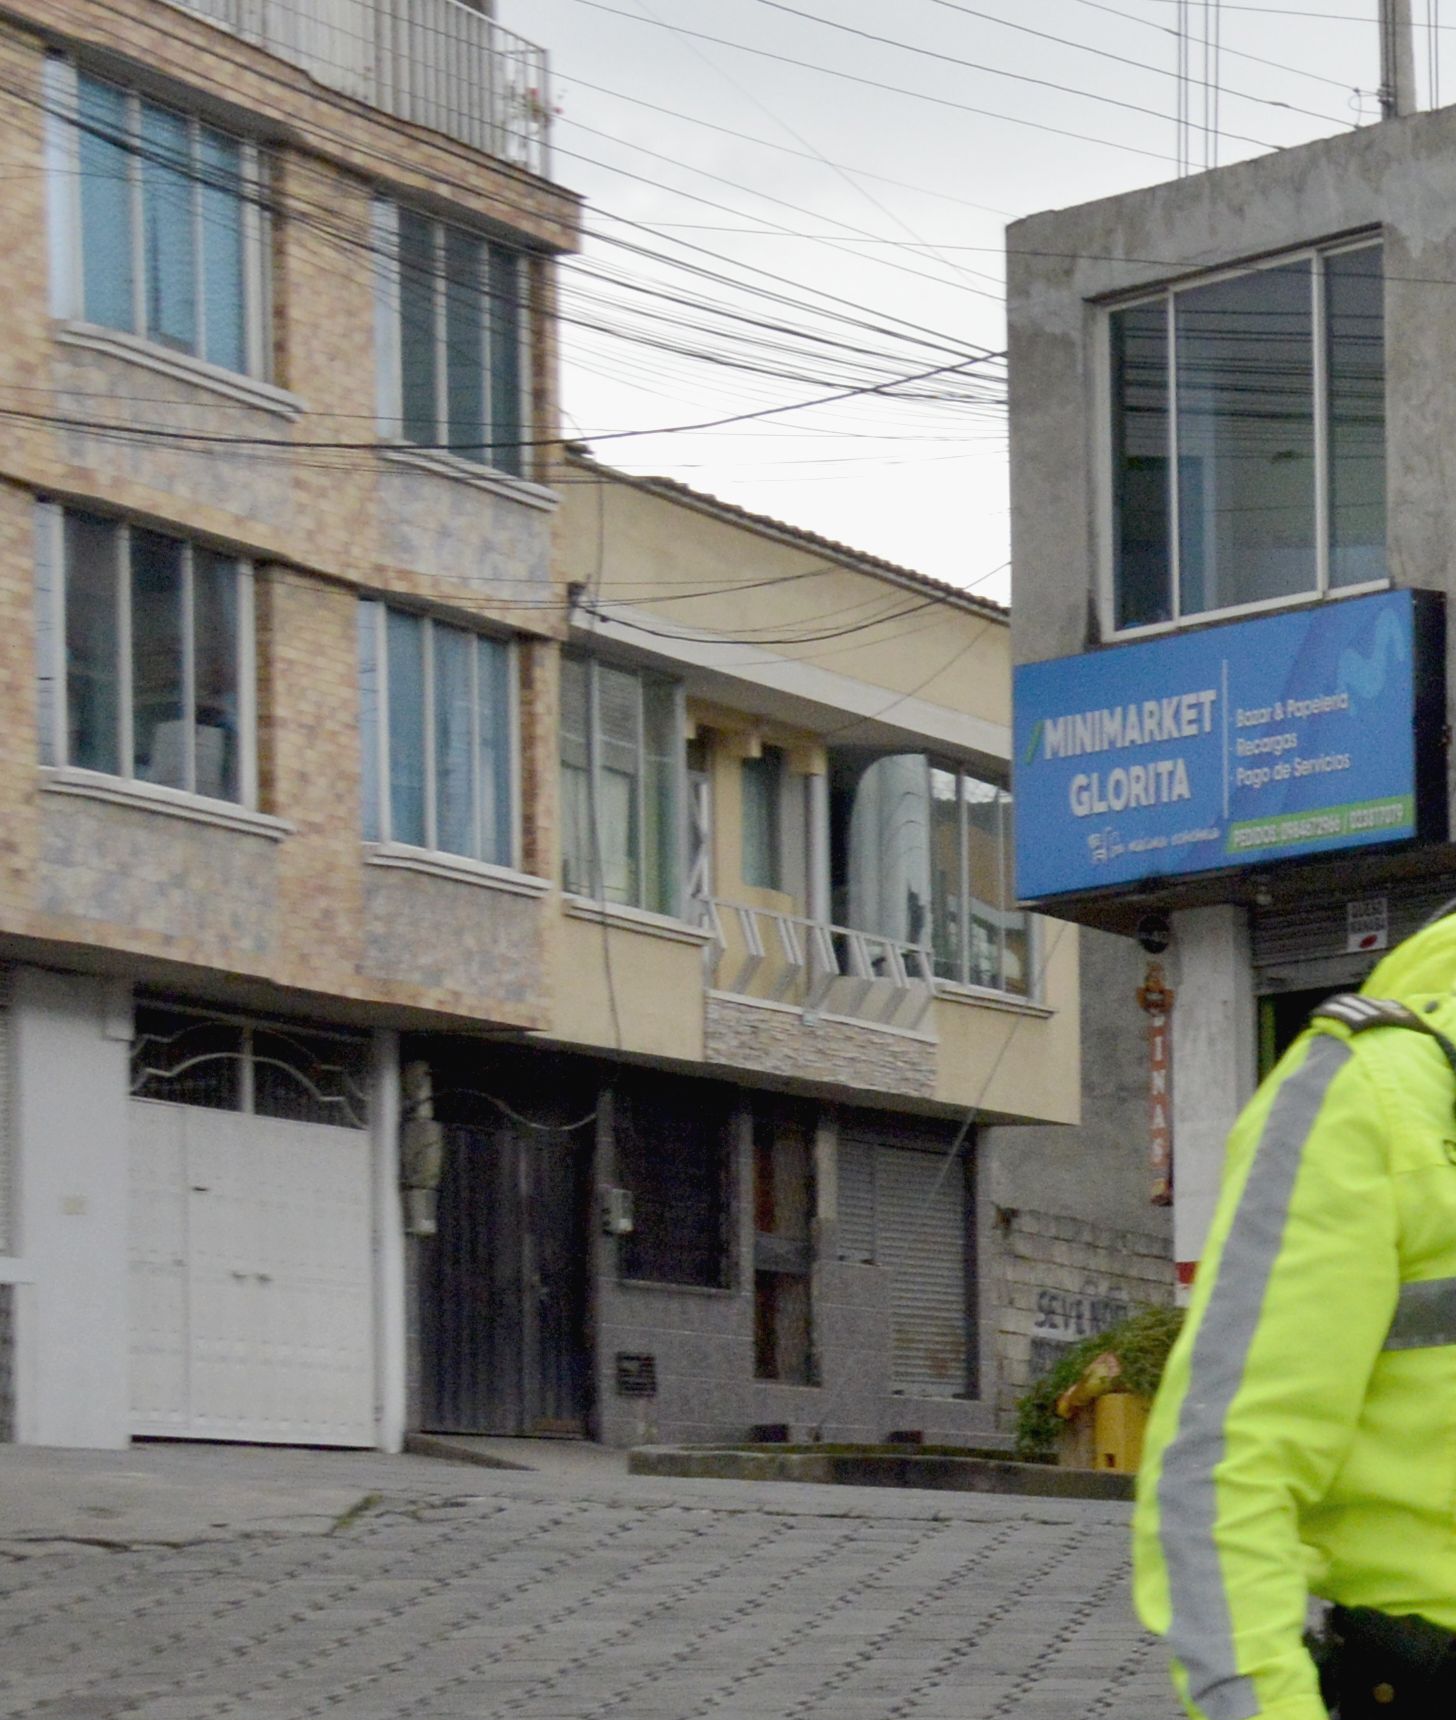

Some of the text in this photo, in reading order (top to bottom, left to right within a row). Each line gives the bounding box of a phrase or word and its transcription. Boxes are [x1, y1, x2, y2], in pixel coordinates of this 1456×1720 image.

[1043, 689, 1217, 760] MINIMARKET
[1235, 707, 1273, 728] Bazar
[1236, 732, 1298, 756] Recargas
[1070, 758, 1192, 817] GLORITA
[1237, 753, 1351, 788] Pago de Servicios
